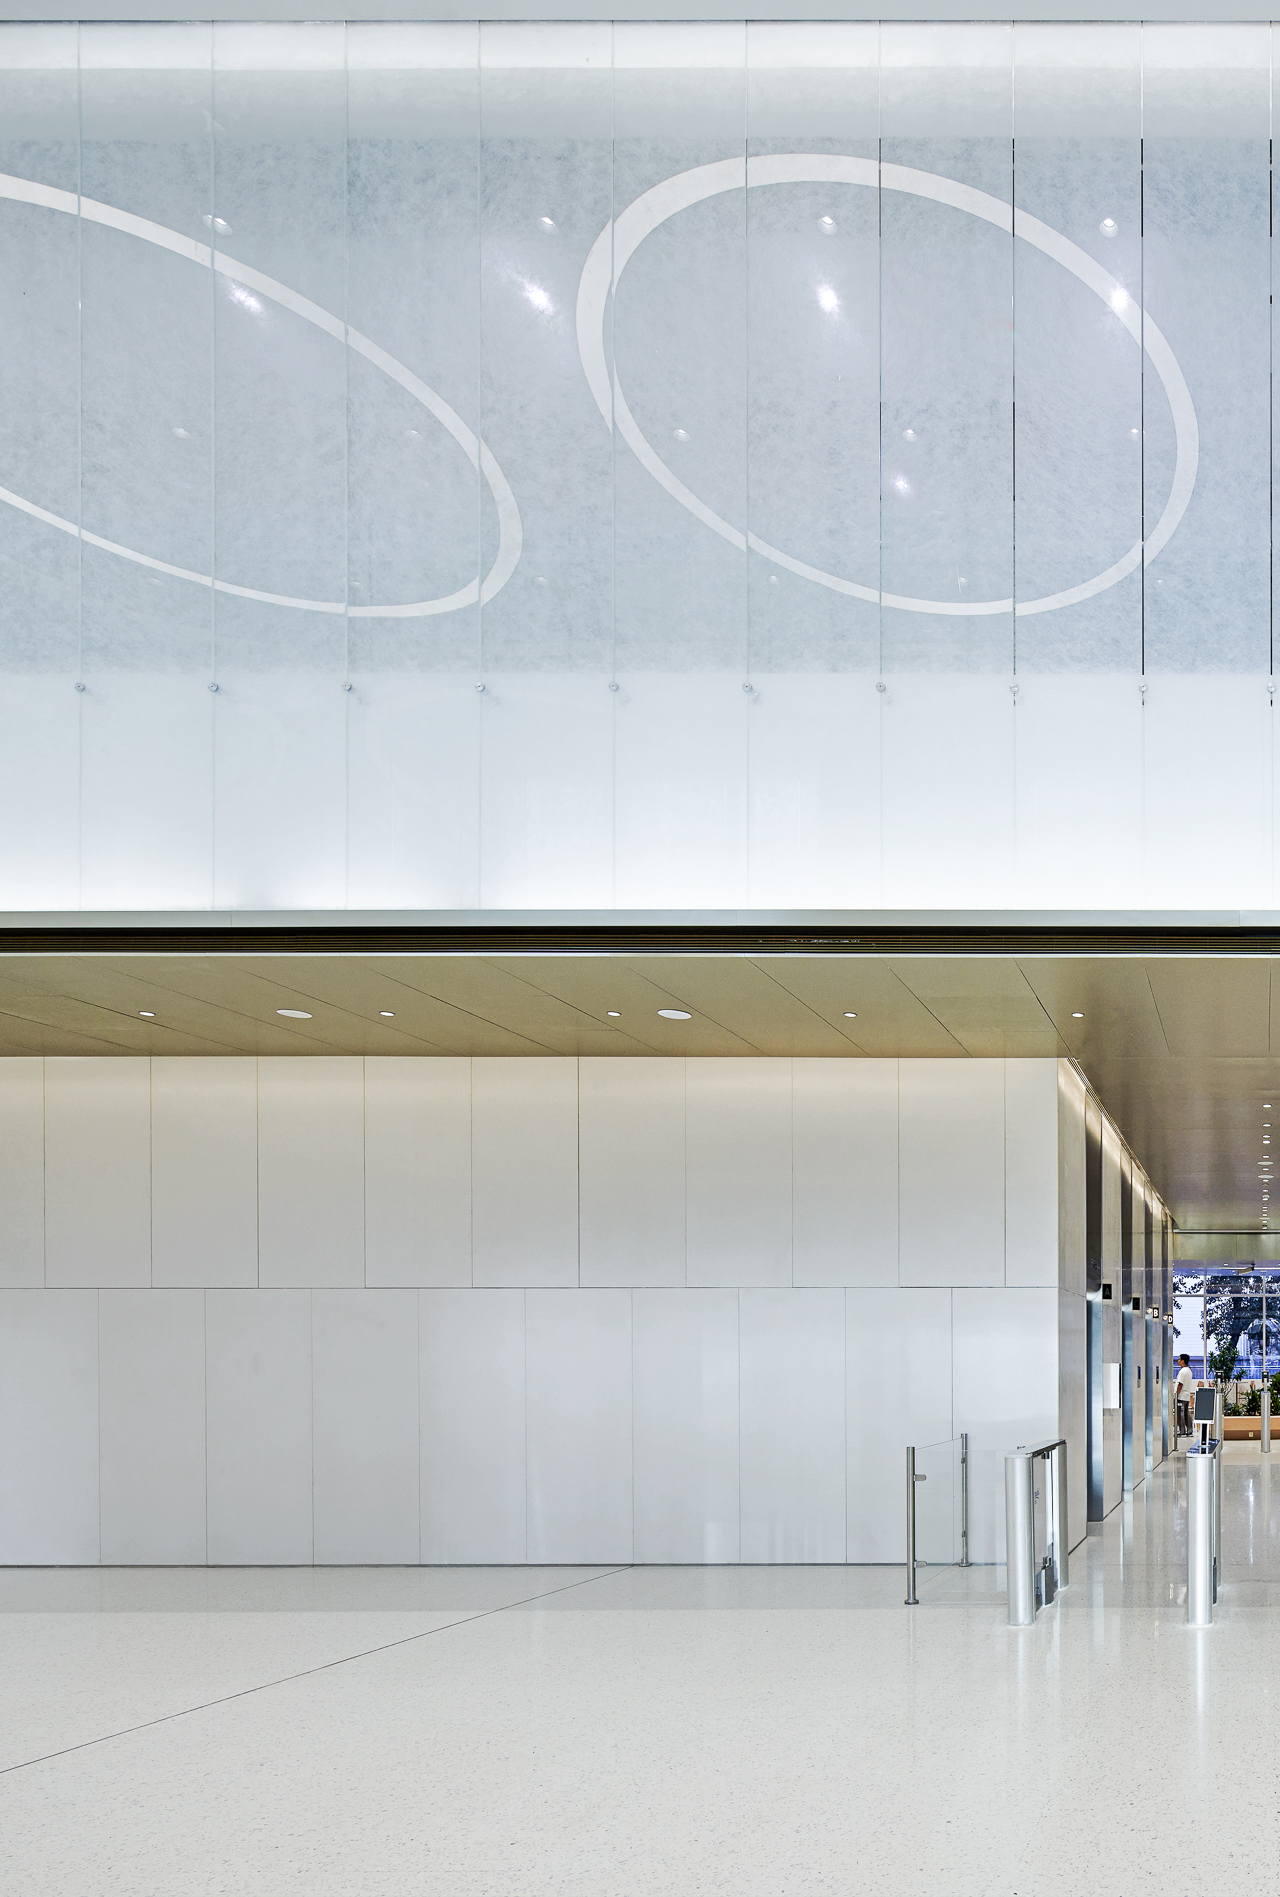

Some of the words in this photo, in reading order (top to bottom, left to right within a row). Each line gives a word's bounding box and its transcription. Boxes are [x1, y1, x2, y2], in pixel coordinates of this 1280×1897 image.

[1104, 1287, 1111, 1297] A
[1153, 1308, 1159, 1318] B
[1168, 1315, 1173, 1323] D
